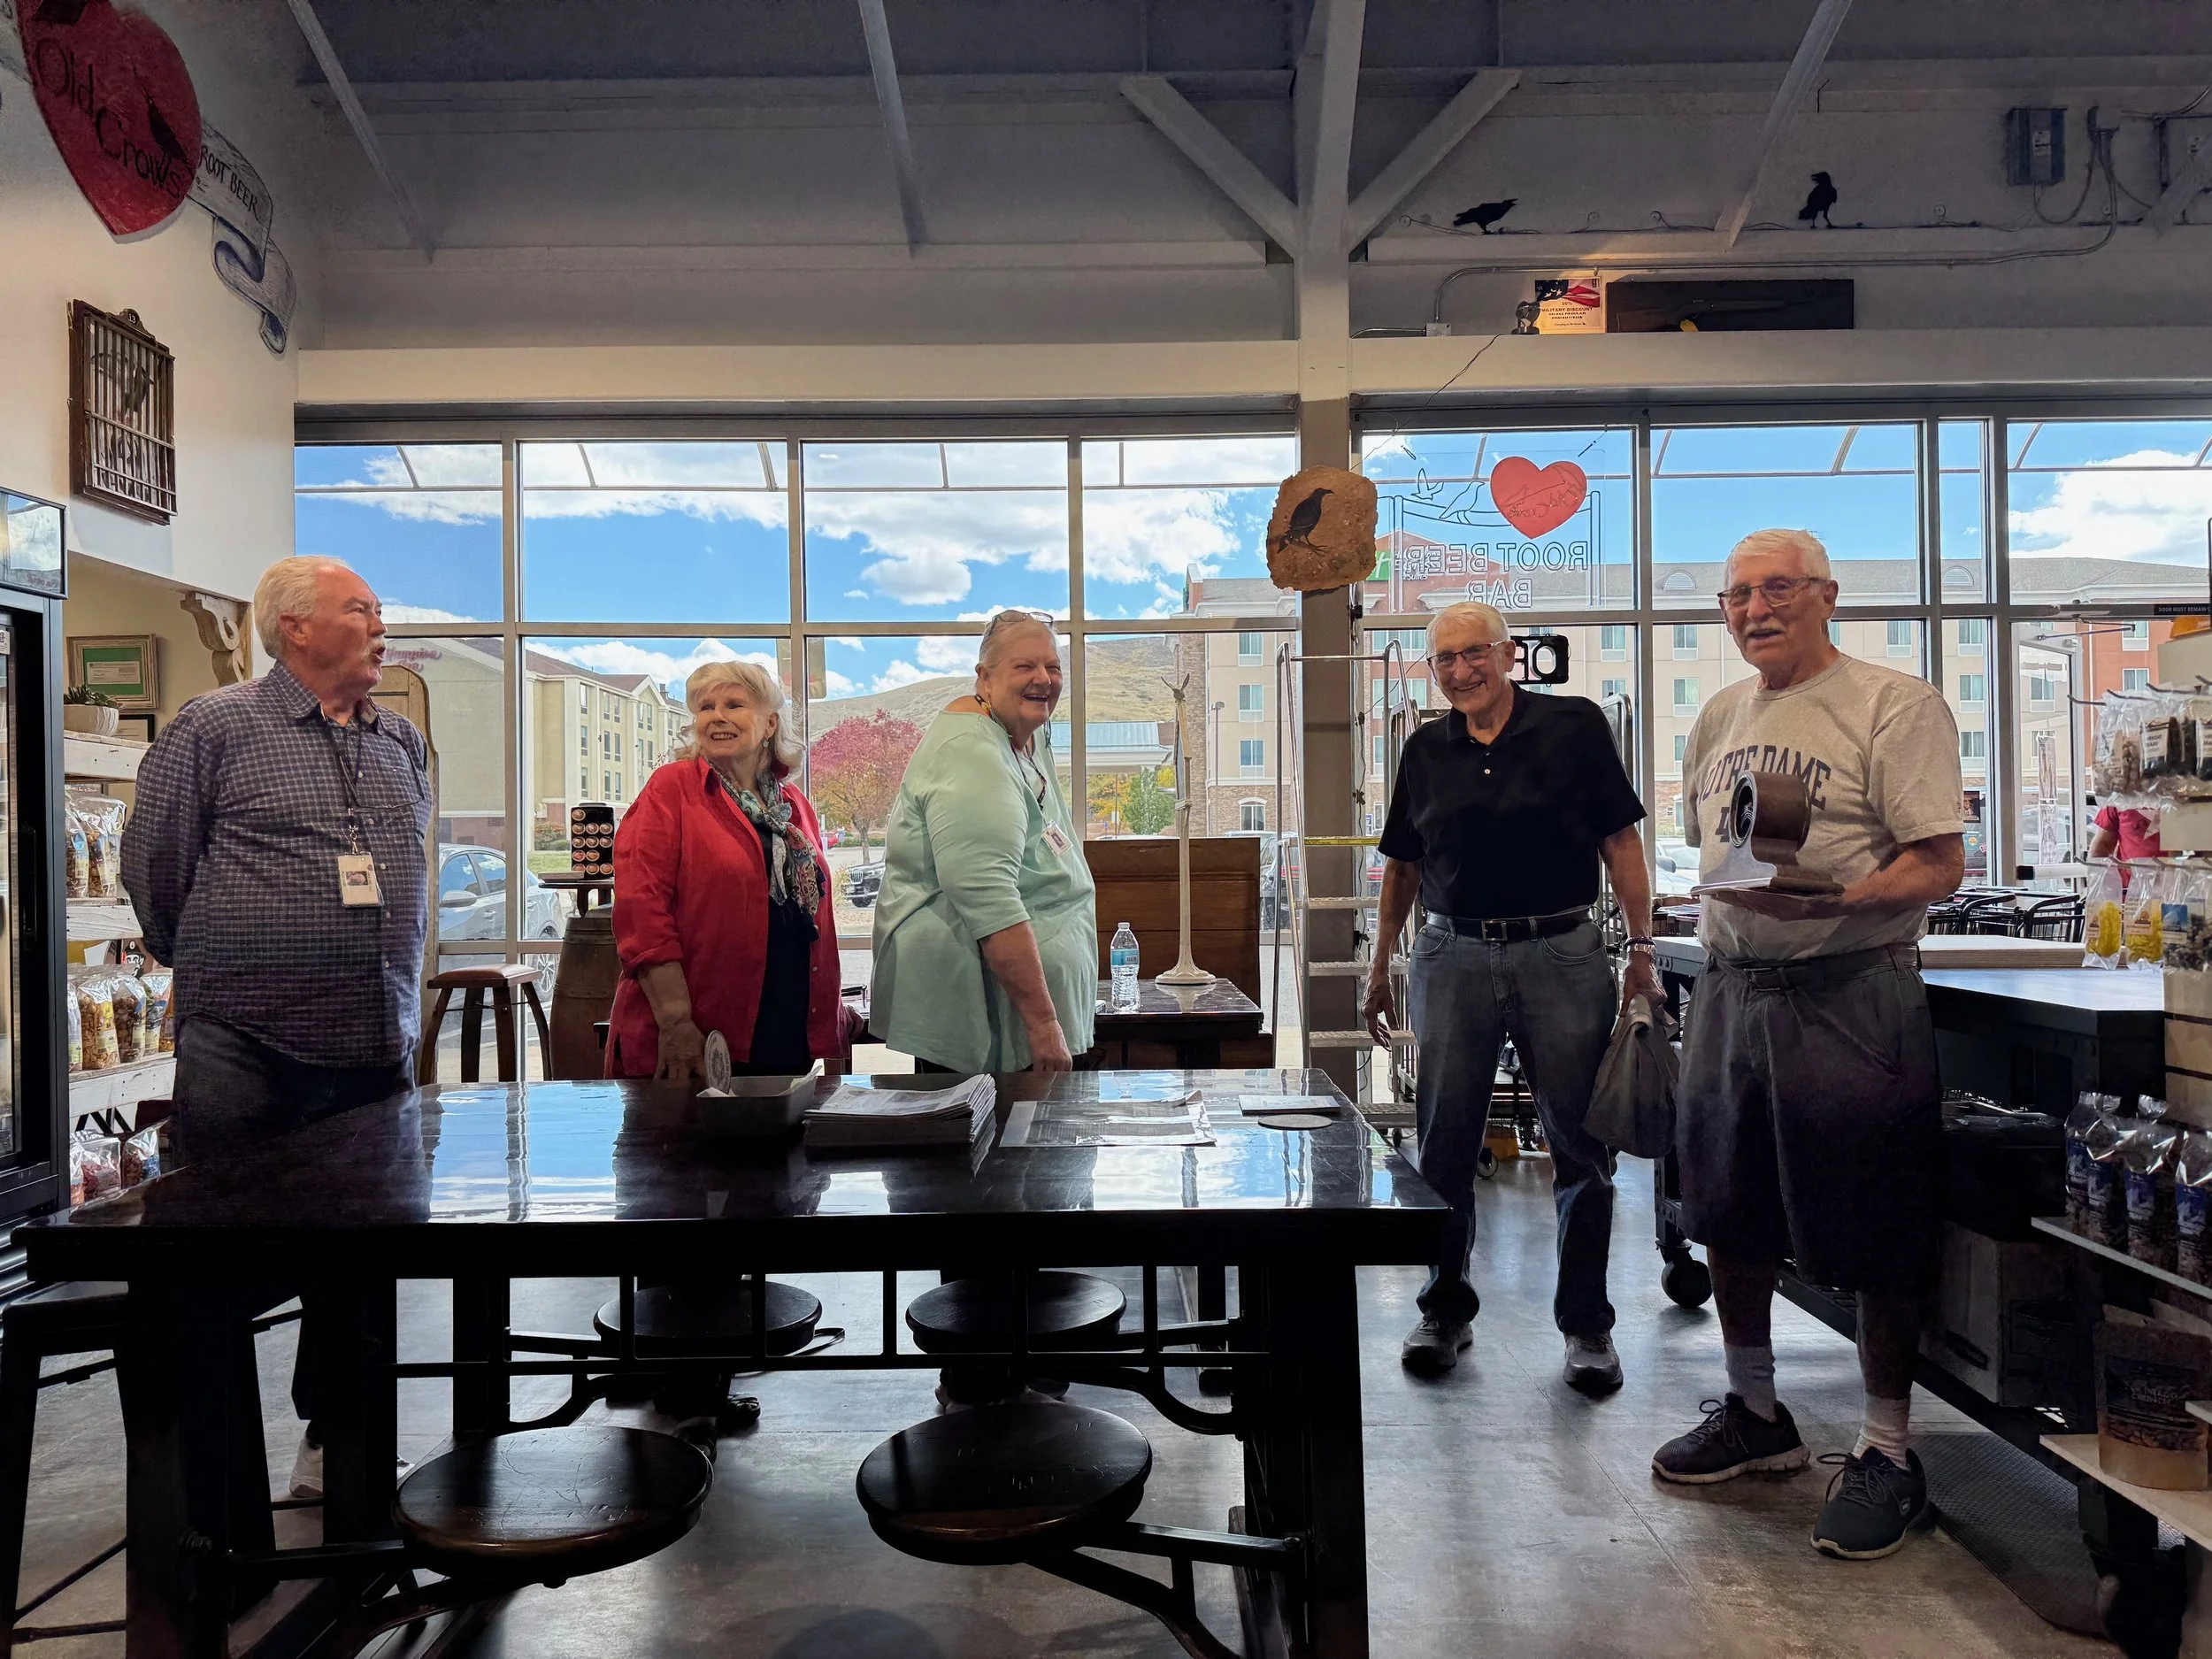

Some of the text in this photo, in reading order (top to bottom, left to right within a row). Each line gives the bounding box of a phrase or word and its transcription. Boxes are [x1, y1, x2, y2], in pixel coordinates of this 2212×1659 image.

[35, 38, 94, 117] Old
[198, 144, 264, 223] ROOT BEER
